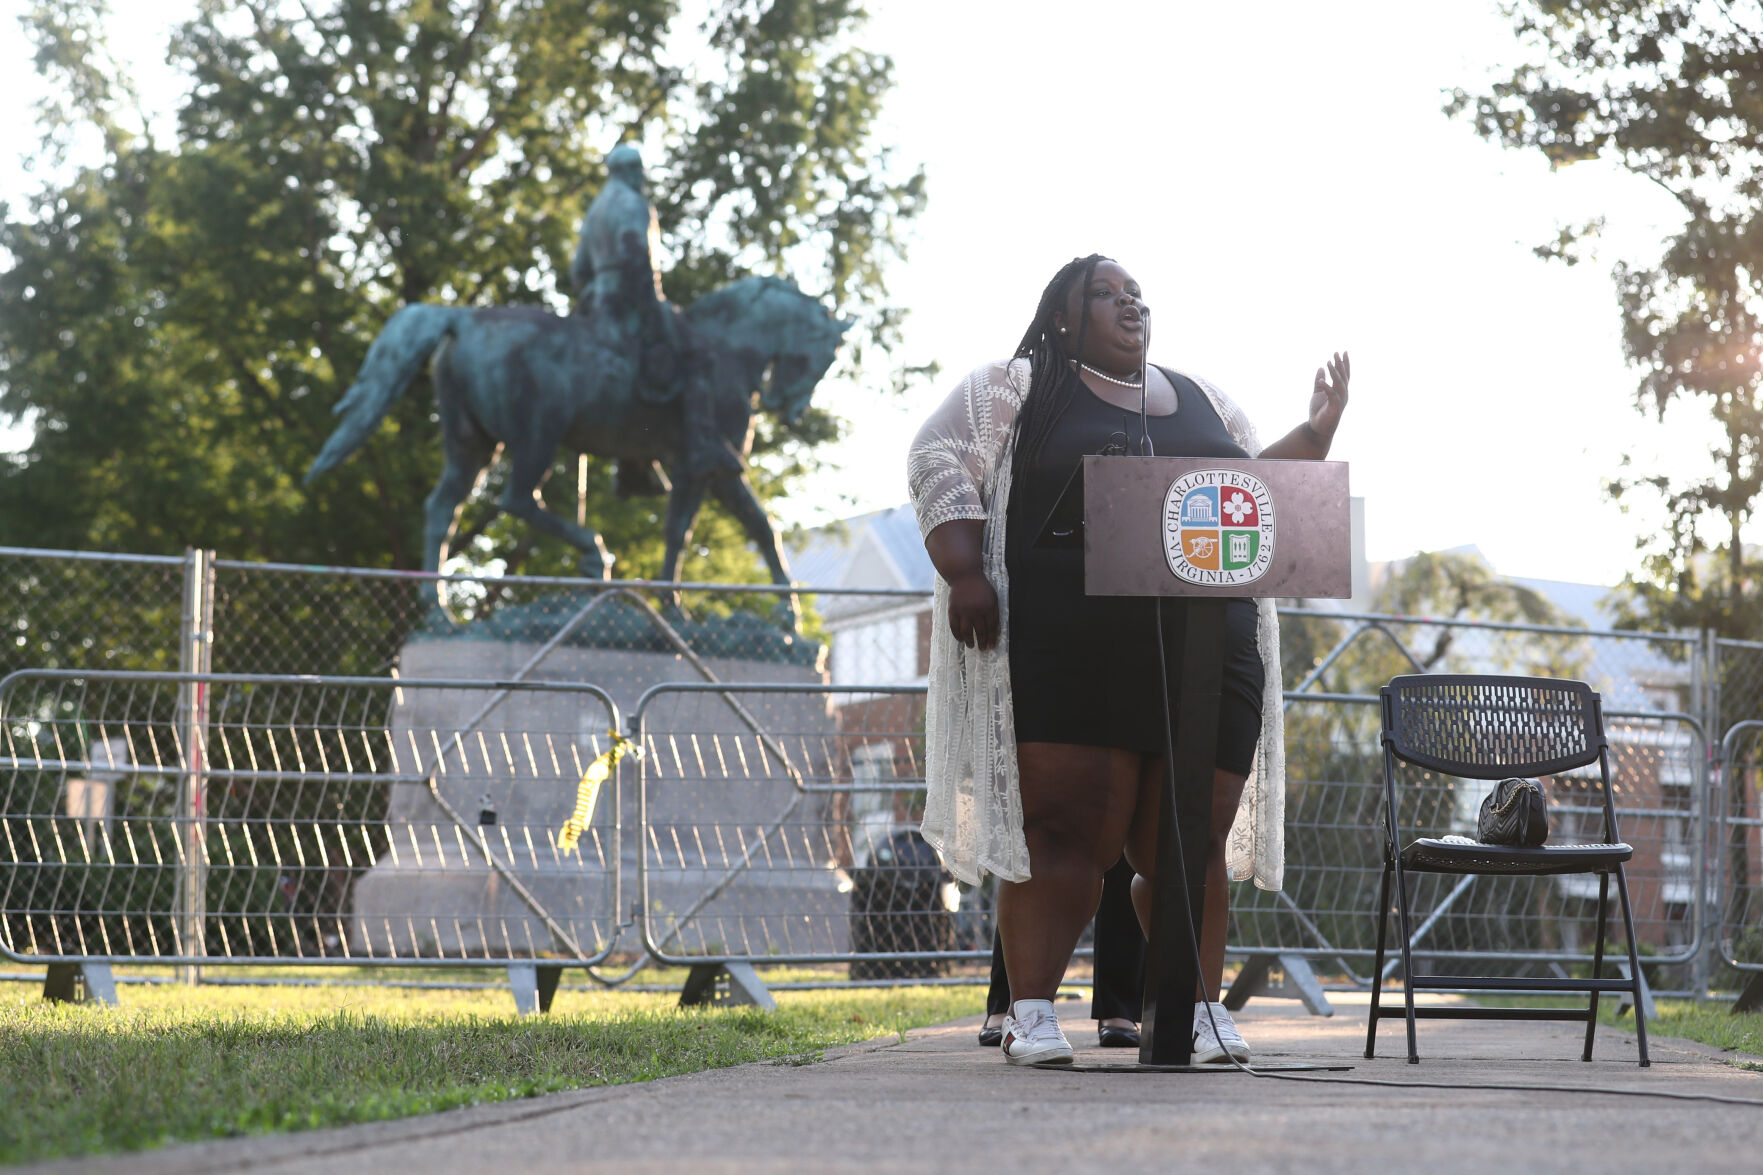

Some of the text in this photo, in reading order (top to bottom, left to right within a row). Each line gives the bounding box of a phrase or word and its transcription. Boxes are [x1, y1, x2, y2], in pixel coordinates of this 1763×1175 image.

[1167, 472, 1273, 533] CHARLOTTESVILLE
[1170, 541, 1271, 583] VIRGINIA 1762
